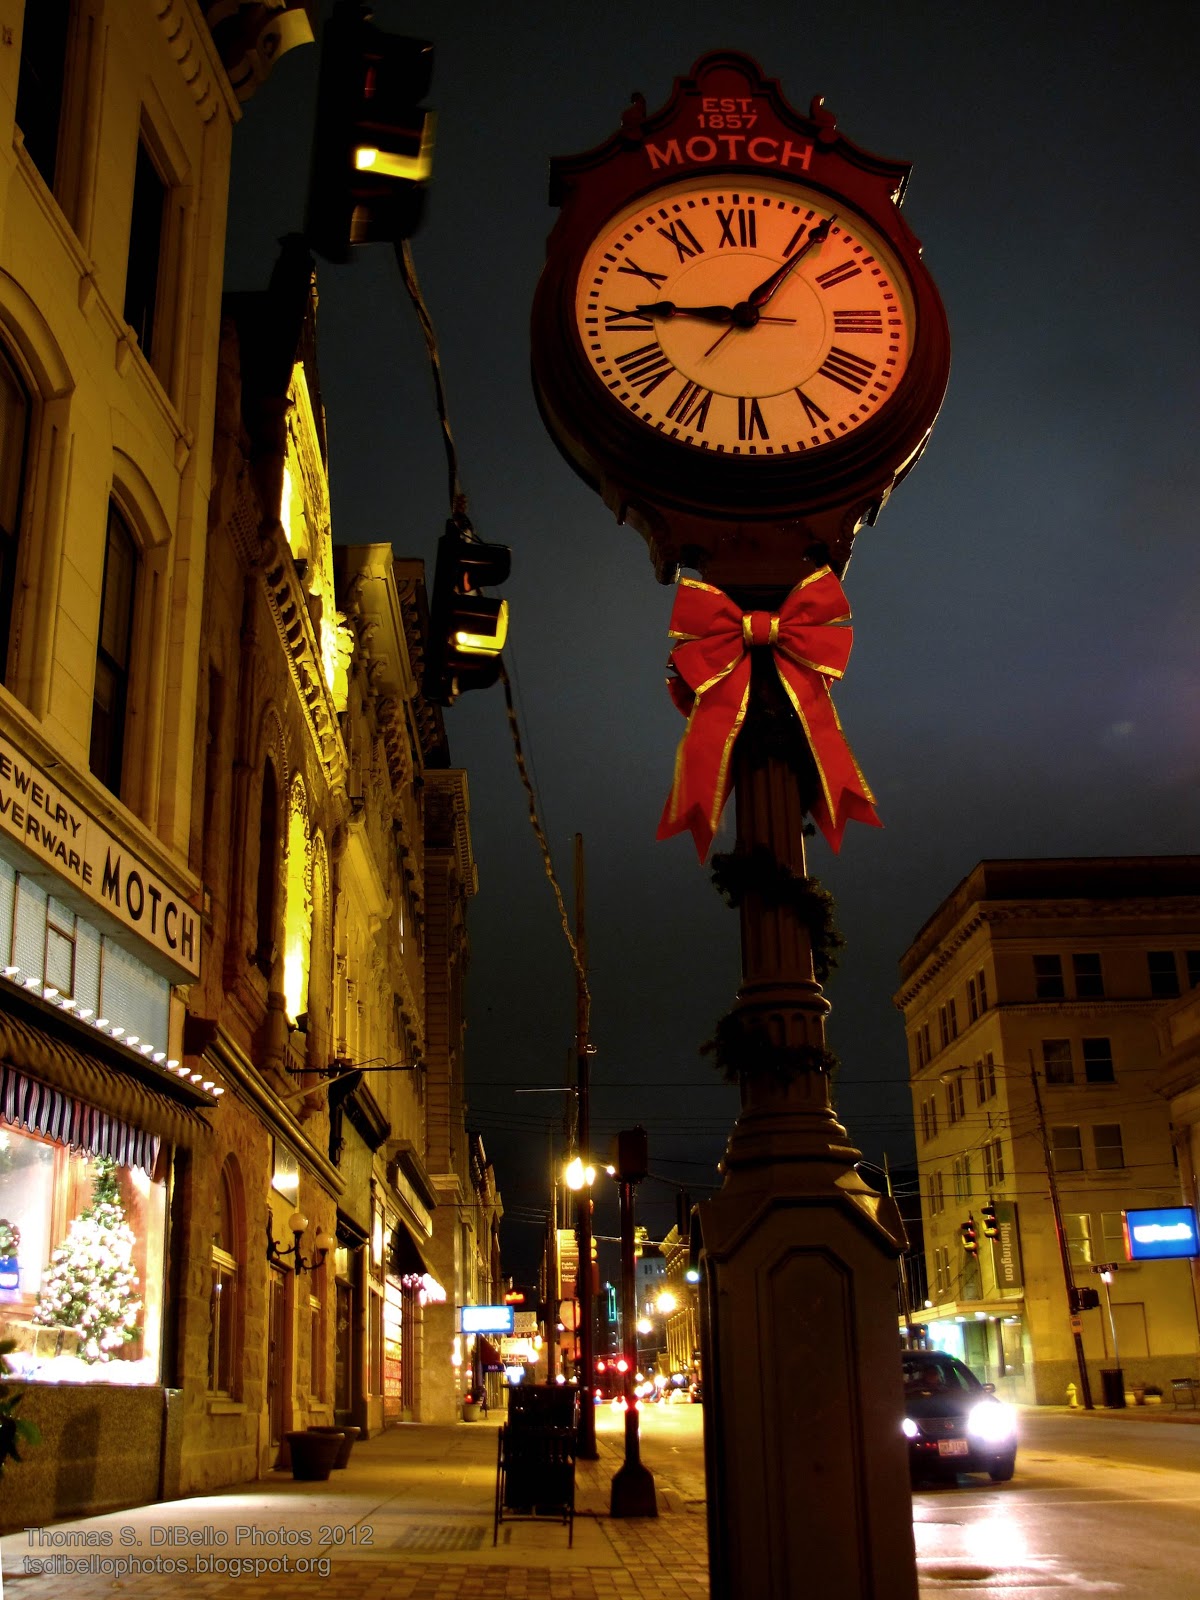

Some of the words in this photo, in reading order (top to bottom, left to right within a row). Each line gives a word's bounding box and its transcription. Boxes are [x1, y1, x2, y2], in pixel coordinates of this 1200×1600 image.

[697, 114, 758, 130] 1857
[701, 98, 757, 114] EST.
[645, 135, 814, 171] MOTCH
[716, 208, 758, 249] XII
[617, 257, 669, 290] X
[0, 752, 82, 838] EWELRY
[0, 789, 93, 885] VERWARE
[101, 846, 195, 962] MOTCH
[1000, 1222, 1014, 1282] Huntington
